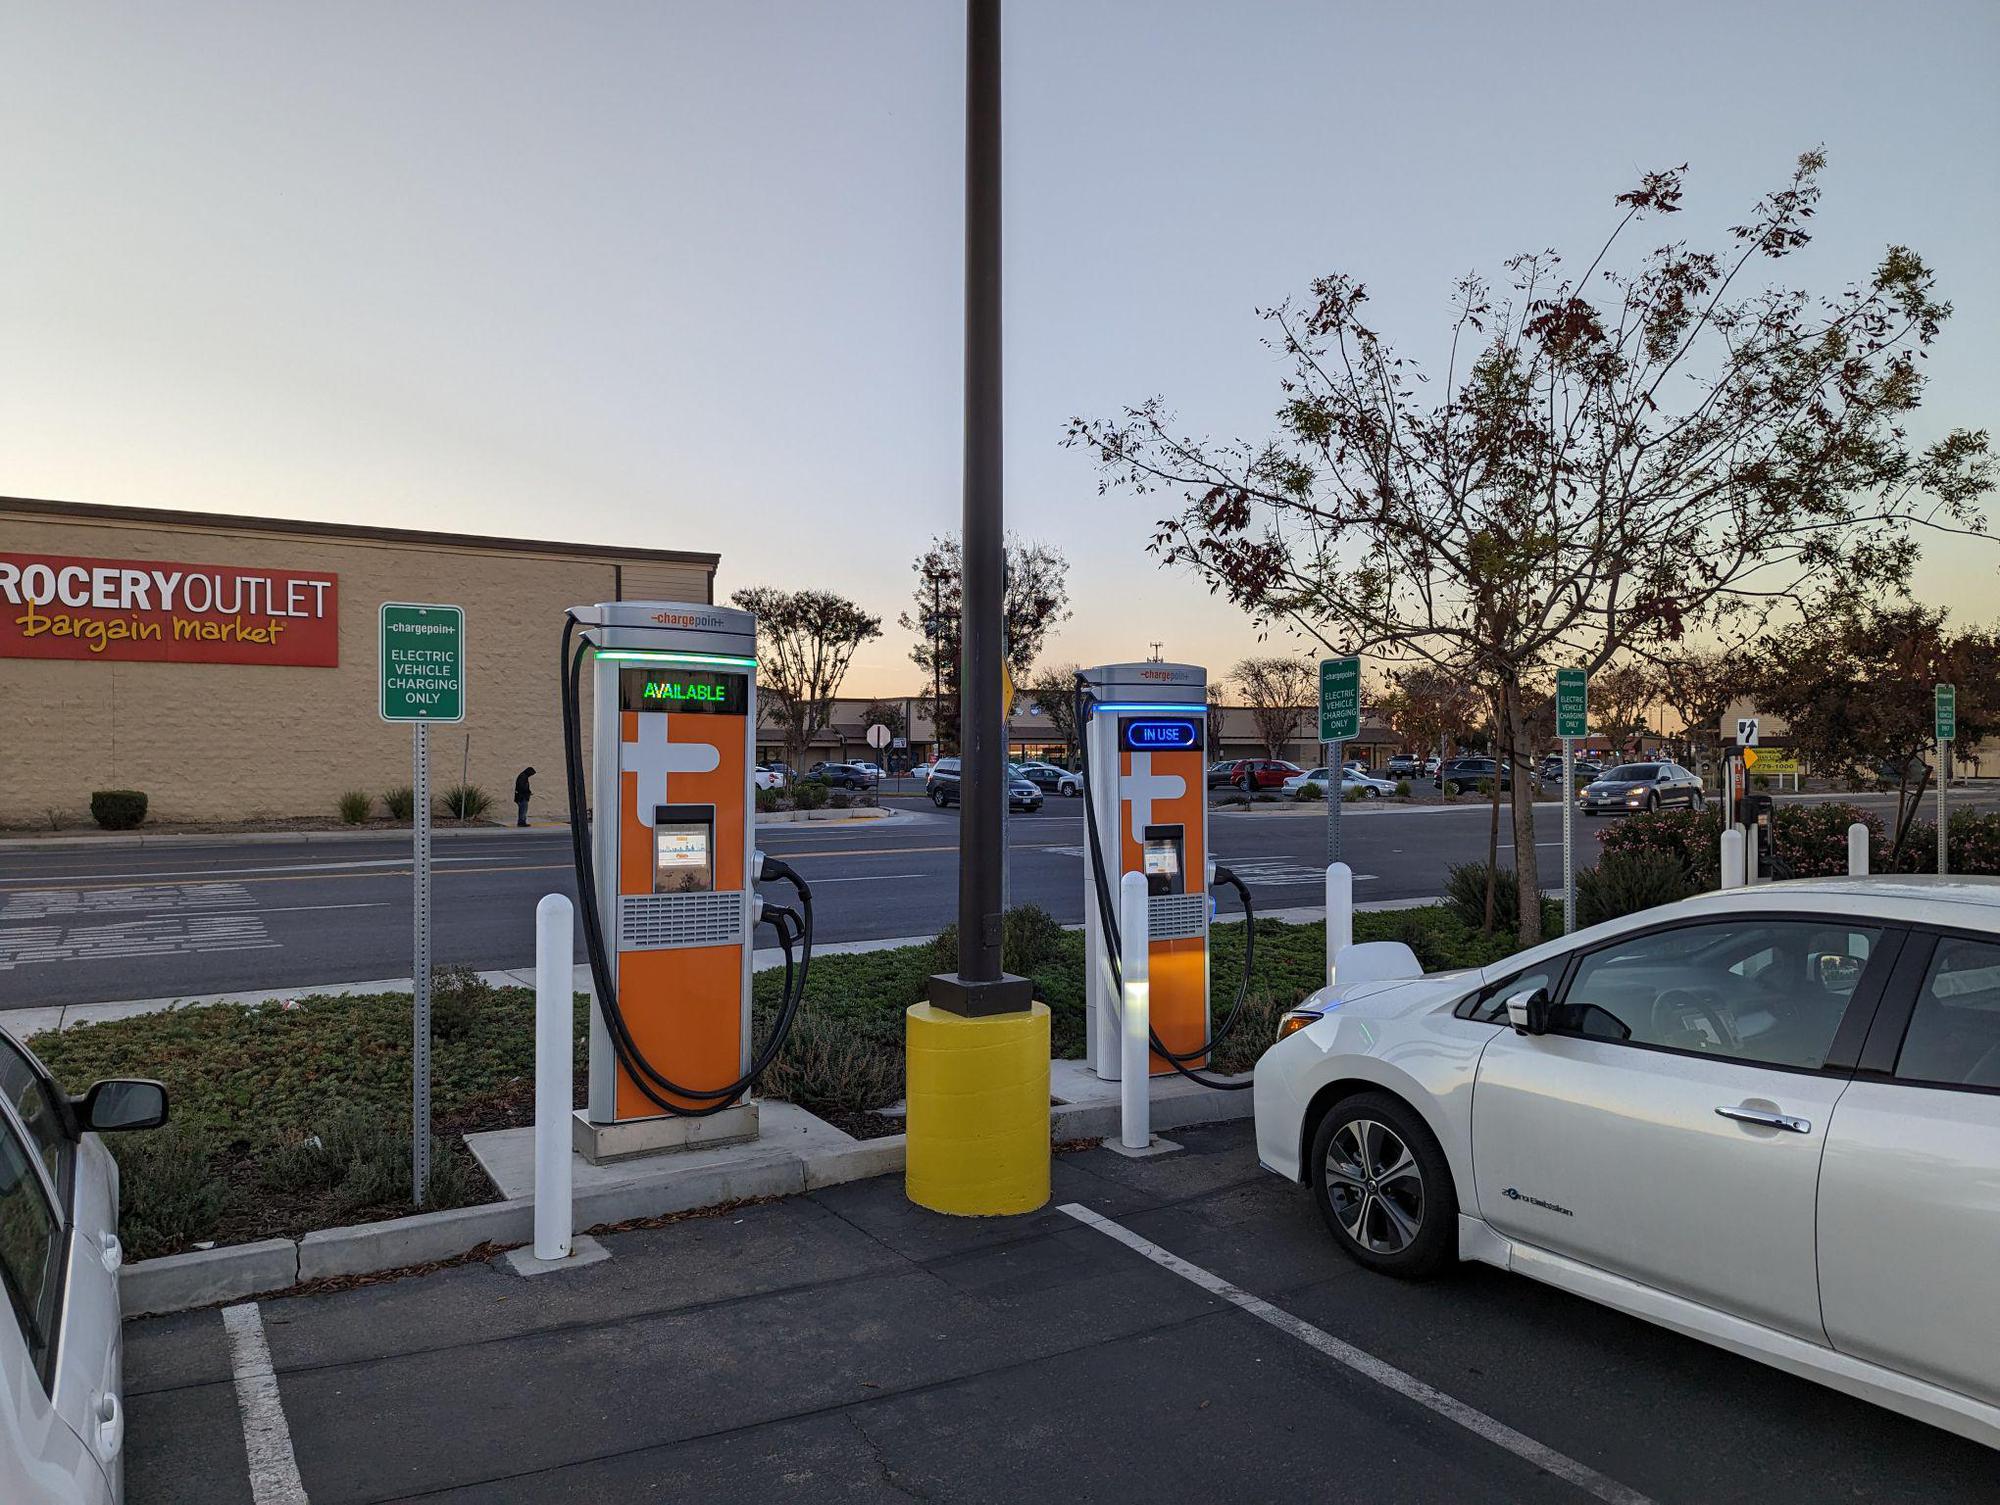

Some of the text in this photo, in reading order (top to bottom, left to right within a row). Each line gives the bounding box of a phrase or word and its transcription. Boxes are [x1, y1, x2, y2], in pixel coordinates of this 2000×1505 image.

[16, 597, 284, 652] bargain market
[391, 649, 454, 662] ELECTRIC
[395, 664, 451, 676] VEHICLE
[387, 678, 458, 690] CHARGING
[405, 692, 441, 704] ONLY
[643, 682, 726, 701] AVAILABLE
[1324, 688, 1356, 701] ELECTRIC
[1326, 699, 1353, 710] VEHICLE
[1322, 708, 1357, 721] CHARGING
[1330, 719, 1349, 729] ONLY
[1144, 728, 1180, 741] IN USE
